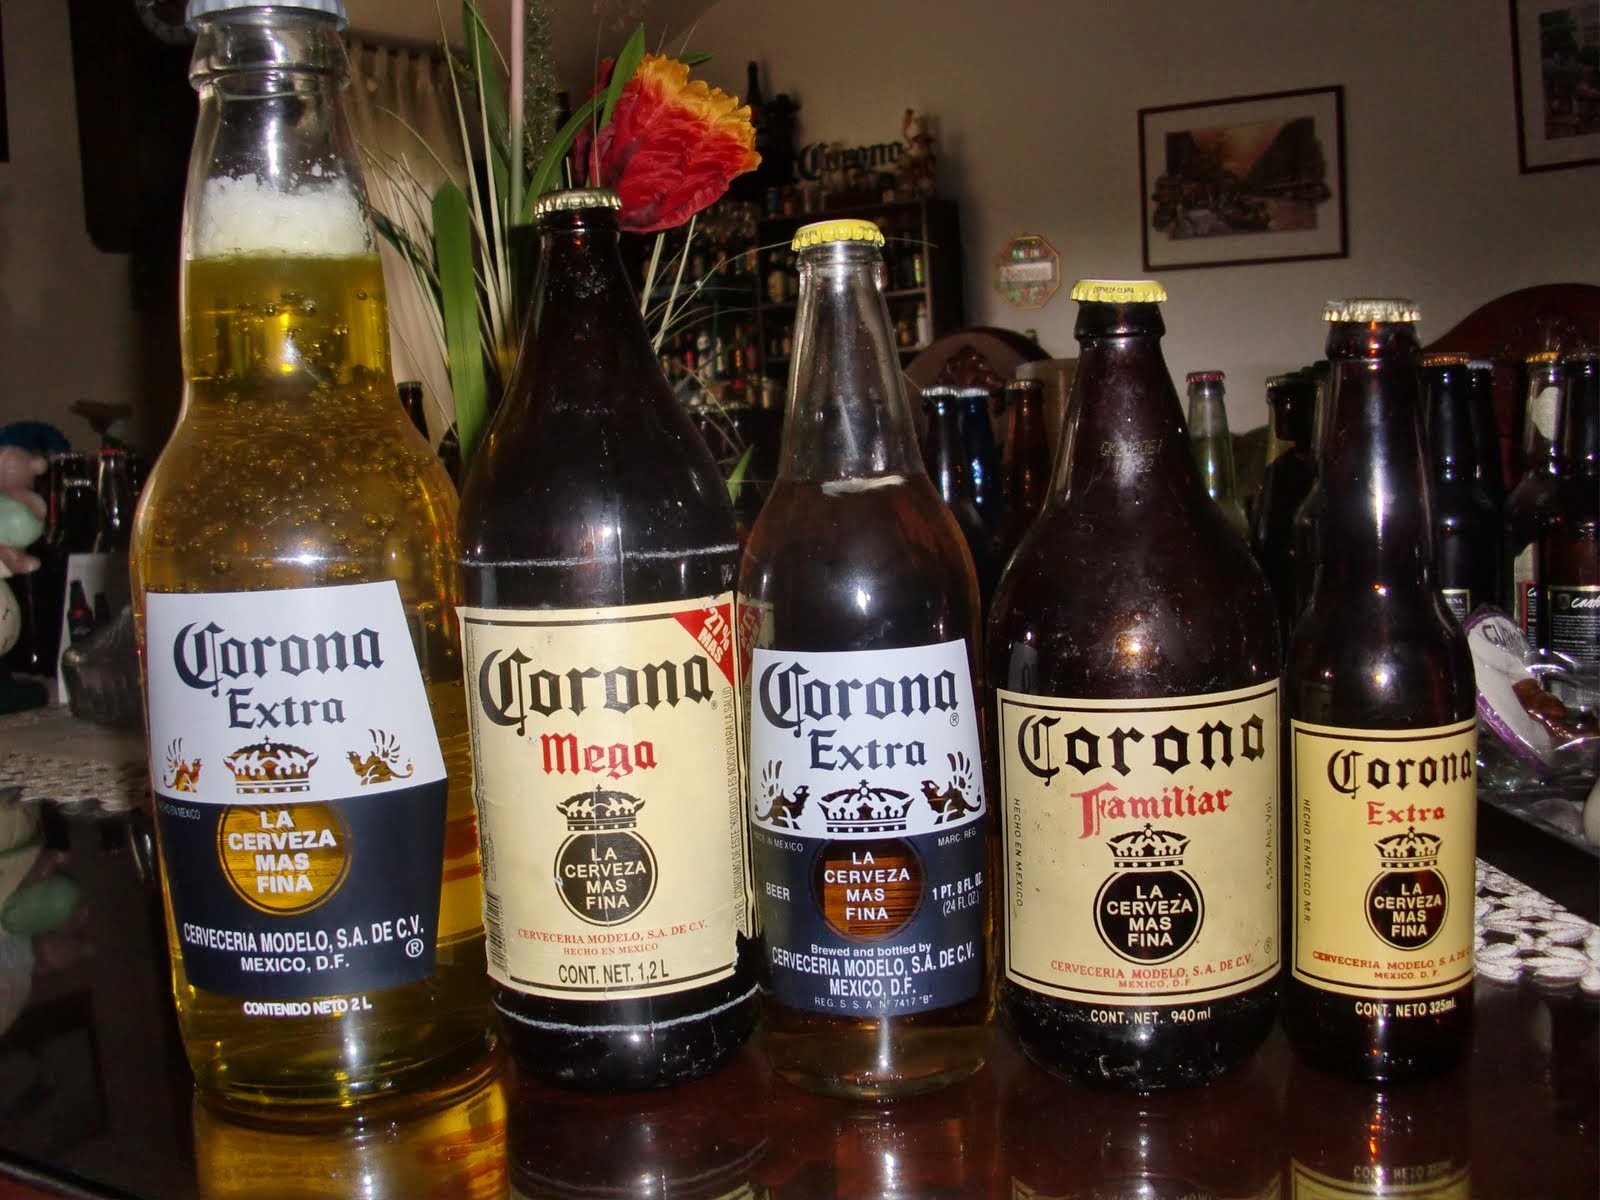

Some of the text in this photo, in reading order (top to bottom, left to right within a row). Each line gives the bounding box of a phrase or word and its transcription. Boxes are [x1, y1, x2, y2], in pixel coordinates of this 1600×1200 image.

[704, 607, 731, 651] 27%
[697, 627, 723, 663] MAS
[173, 621, 384, 697] Corona
[479, 647, 714, 736] Corona
[722, 686, 733, 713] SALUD
[759, 661, 959, 738] Corona
[226, 687, 346, 729] Extra
[724, 714, 734, 725] LA
[725, 725, 735, 745] PARA
[540, 732, 659, 780] Mega
[808, 728, 928, 771] Extra
[1017, 713, 1265, 787] Corona
[726, 746, 737, 776] NOCIVO
[728, 776, 738, 786] ES
[1327, 749, 1472, 800] Corona
[261, 810, 294, 828] LA
[1070, 782, 1232, 839] Familiar
[1303, 799, 1311, 835] HECHO
[1366, 801, 1446, 825] Extra
[228, 829, 337, 850] CERVEZA
[731, 830, 740, 849] ESTE
[774, 838, 804, 852] MEXICO
[1304, 838, 1312, 853] EN
[255, 853, 309, 871] MAS
[591, 847, 618, 861] LA
[732, 849, 741, 859] DE
[852, 851, 875, 865] LA
[1013, 798, 1024, 907] HECHO EN MEXICO
[564, 861, 647, 879] CERVEZA
[732, 860, 743, 899] CONSUMO
[824, 868, 911, 883] CERVEZA
[1303, 855, 1312, 896] MEXICO
[257, 874, 313, 893] FINA
[586, 878, 627, 894] MAS
[766, 882, 790, 901] BEER
[932, 887, 938, 900] 1
[941, 883, 956, 899] PT.
[957, 881, 963, 894] 8
[1136, 885, 1164, 899] LA
[1401, 883, 1422, 896] LA
[586, 894, 630, 910] FINA
[846, 888, 885, 902] MAS
[1374, 894, 1442, 910] CERVEZA
[846, 907, 889, 921] FINA
[1106, 898, 1193, 916] CERVEZA
[1392, 910, 1427, 923] MAS
[184, 914, 424, 952] CERVECERIA MODELO, S.A. DE C.V.
[517, 919, 708, 945] CERVECERIA MODELO, S.A. DE C.V.
[1129, 917, 1172, 931] MAS
[1391, 924, 1428, 937] FINA
[563, 943, 659, 956] HECHO EN MEXICO
[811, 942, 932, 957] Brewed and bottled by
[1128, 933, 1173, 947] FINA
[241, 954, 350, 974] MEXICO, D.F.
[772, 942, 975, 978] CERVECERIA MODELO, S.A. DE C.V.
[1051, 960, 1125, 979] CERVECERIA
[1220, 960, 1234, 972] DE
[1236, 955, 1254, 968] C.V.
[1312, 951, 1380, 969] CERVECERIA
[558, 958, 670, 984] CONT. NET. 1,2 L
[830, 977, 916, 999] MEXICO, D.F.
[243, 996, 373, 1017] CONTENIDO NETO 2 L
[814, 996, 837, 1008] REG.
[894, 997, 916, 1007] 7417
[1355, 1001, 1391, 1017] CONT.
[1396, 1002, 1426, 1017] NETO
[1090, 1009, 1130, 1025] CONT.
[1134, 1010, 1164, 1025] NET.
